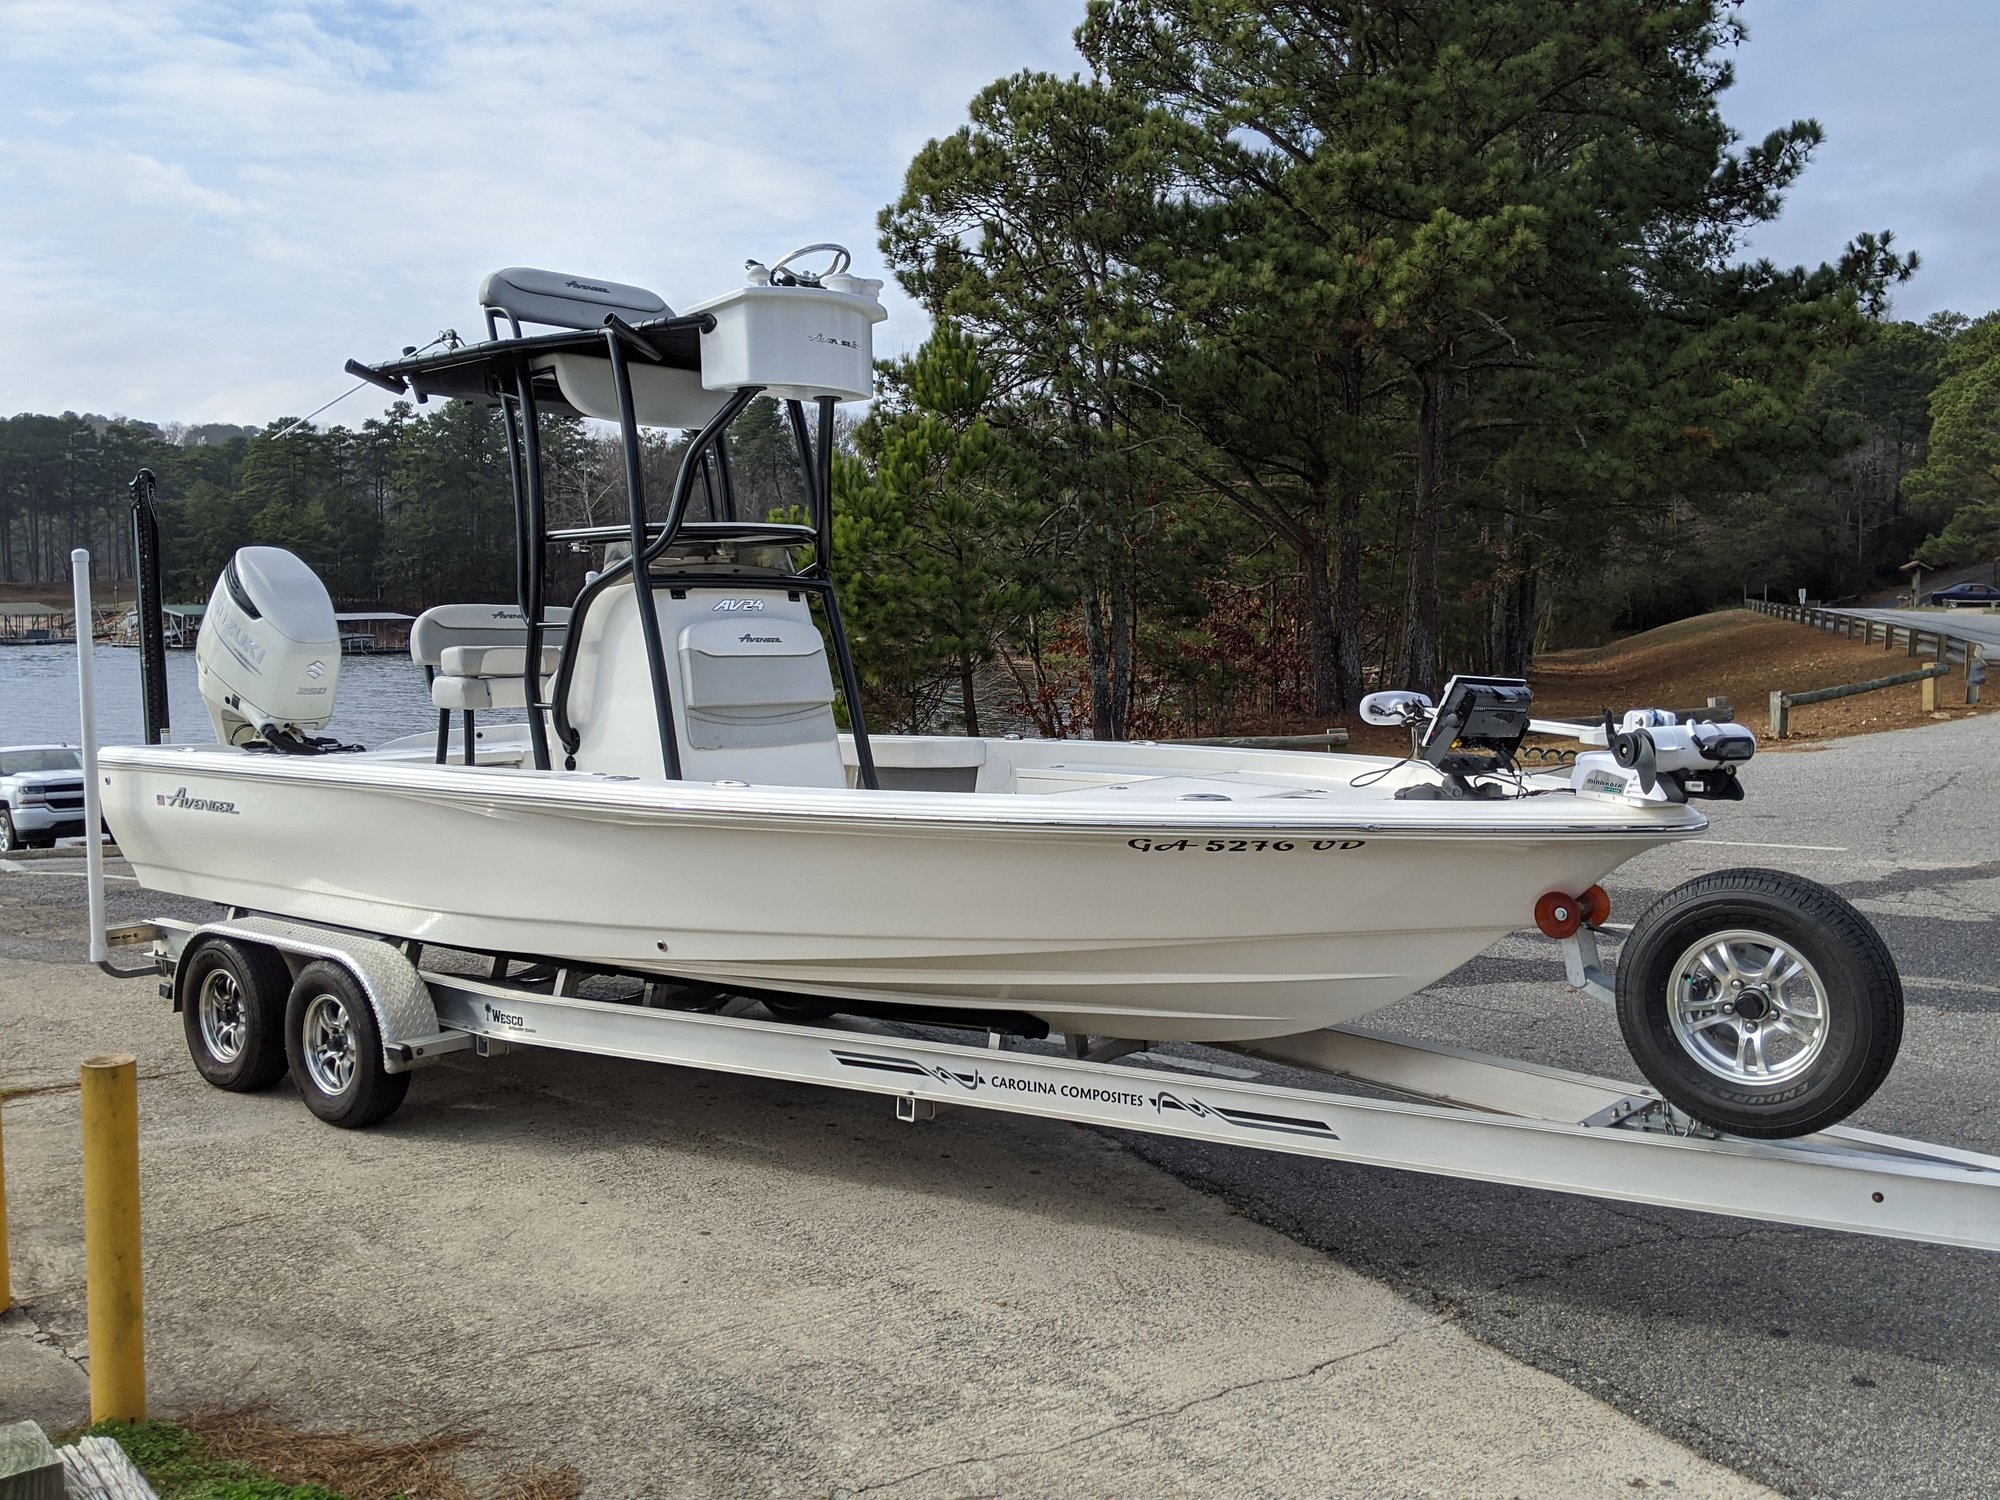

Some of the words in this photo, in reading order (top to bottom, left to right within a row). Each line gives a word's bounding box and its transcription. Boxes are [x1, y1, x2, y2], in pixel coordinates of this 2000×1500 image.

[712, 599, 765, 611] AV24
[739, 633, 782, 643] AVENGER
[296, 686, 327, 695] 250
[166, 787, 239, 814] AVENGER
[1128, 838, 1198, 852] GA
[1205, 839, 1295, 852] 5276
[1308, 840, 1366, 851] UD
[492, 1009, 524, 1027] WESCO
[991, 1075, 1057, 1095] CAROLINA
[1060, 1085, 1144, 1107] COMPOSITES
